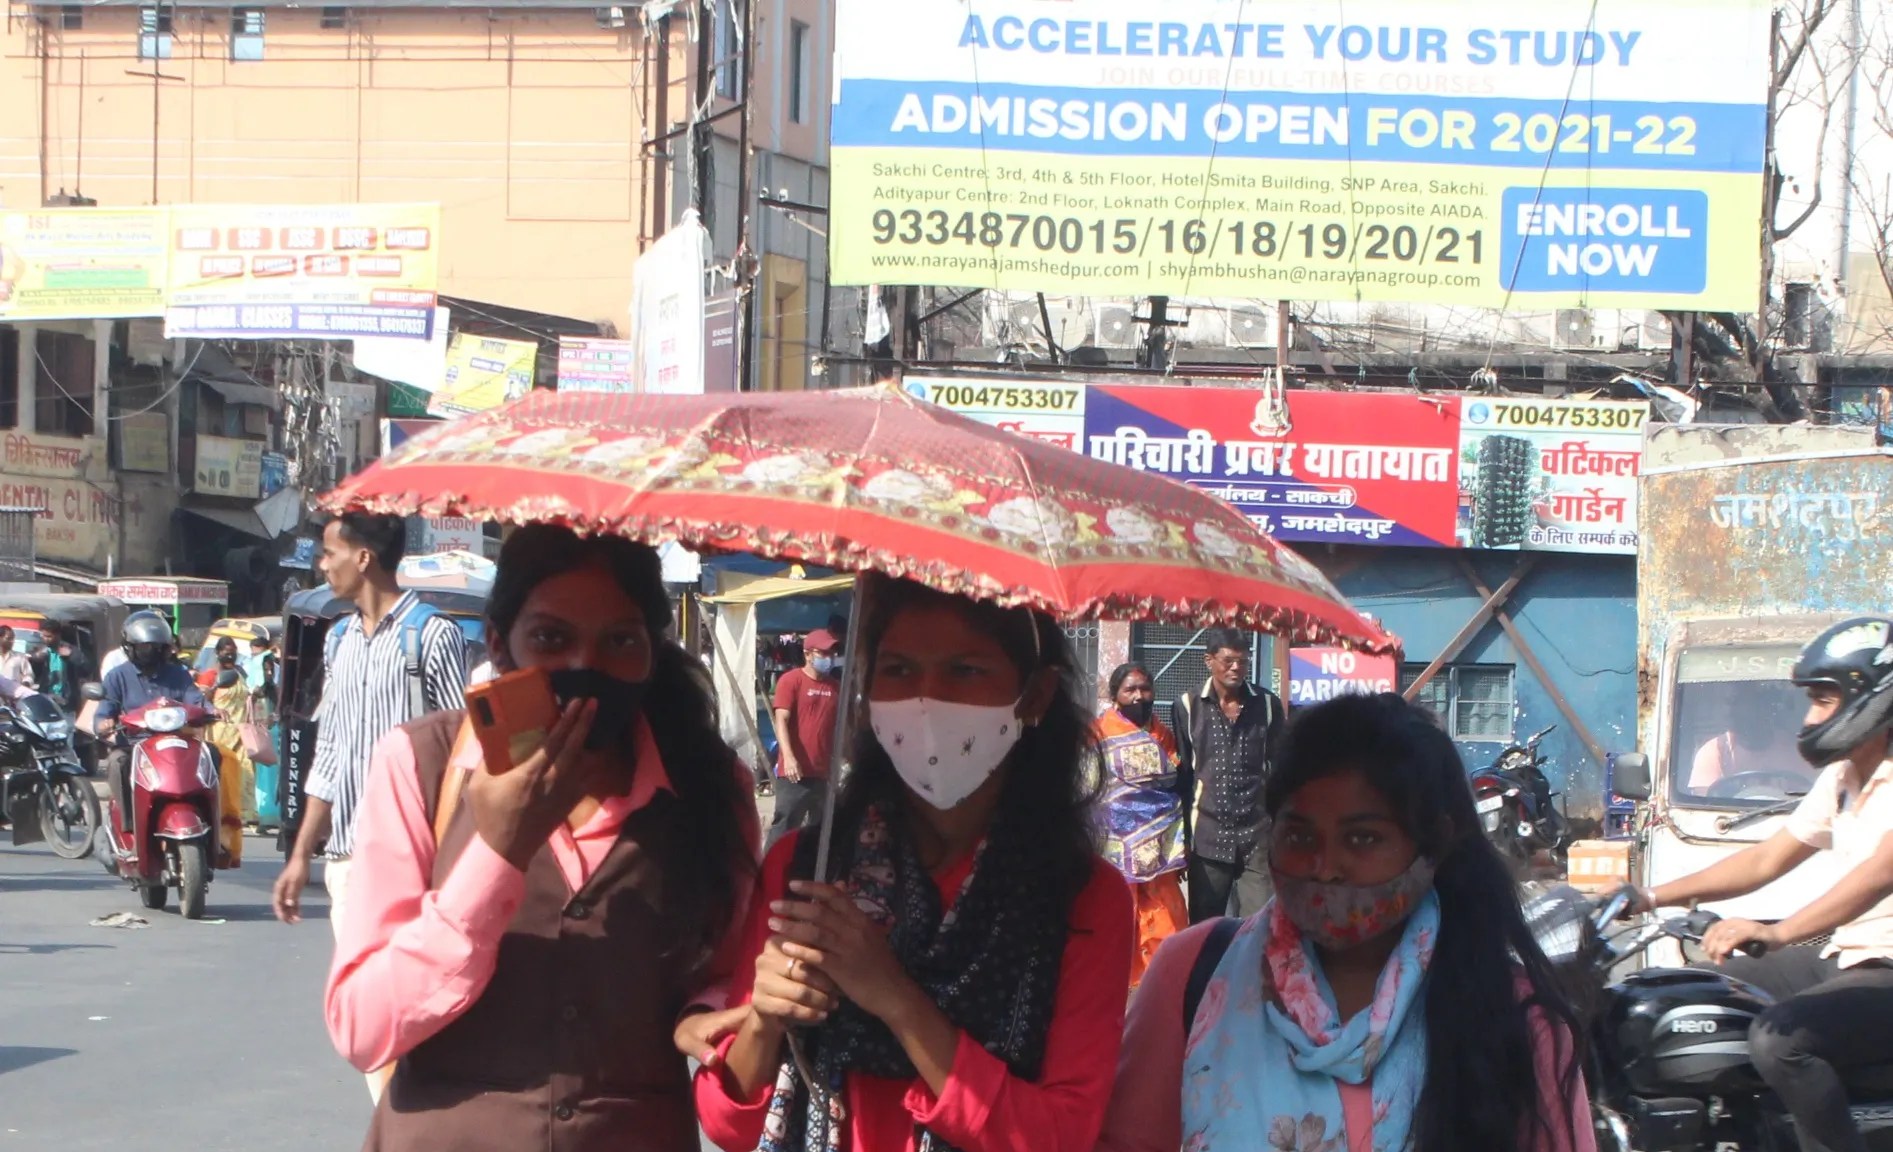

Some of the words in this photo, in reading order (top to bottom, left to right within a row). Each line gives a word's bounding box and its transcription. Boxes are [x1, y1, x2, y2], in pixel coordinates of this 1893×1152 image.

[958, 14, 1285, 58] ACCELERATE
[1303, 24, 1448, 65] YOUR
[1467, 29, 1642, 67] STUDY
[1096, 67, 1155, 86] JOIN
[1168, 68, 1221, 88] OUR
[1233, 69, 1365, 91] FULL-TIME
[1378, 71, 1495, 94] COURSES
[890, 93, 1189, 142] ADMISSION
[1203, 101, 1349, 147] OPEN
[1366, 107, 1475, 149] FOR
[1490, 113, 1697, 156] 2021-22
[872, 163, 927, 178] Sakchi
[932, 164, 990, 180] Centre:
[996, 167, 1026, 183] 3rd,
[1032, 168, 1057, 183] 4th
[1063, 170, 1074, 184] &
[1080, 170, 1104, 186] 5th
[1110, 173, 1156, 188] Floor,
[1162, 173, 1204, 187] Hotel
[1209, 173, 1256, 189] Smita
[1262, 175, 1334, 194] Building,
[1341, 177, 1376, 191] SNP
[1380, 179, 1422, 195] Area,
[1429, 180, 1488, 196] Sakchi.
[873, 186, 951, 203] Adityapur
[956, 187, 1013, 204] Centre:
[1019, 191, 1048, 206] 2nd
[1053, 193, 1097, 211] Floor,
[1104, 195, 1168, 210] Loknath
[1174, 197, 1250, 214] Complex,
[1256, 198, 1294, 213] Main
[1299, 200, 1345, 216] Road,
[1352, 201, 1425, 218] Opposite
[1430, 203, 1488, 220] AIADA.
[872, 208, 1482, 266] 9334870015/16/18/19/20/21
[1517, 203, 1691, 238] ENROLL
[871, 253, 1140, 278] www.narayanajamshedpur.com
[1159, 259, 1481, 288] shyambhushan@narayanagroup.com
[1547, 242, 1659, 277] NOW
[931, 385, 1079, 410] 7004753307
[1495, 404, 1645, 428] 7004753307
[1225, 440, 1297, 478] प्रवर
[1303, 444, 1452, 483] यातायात
[1540, 441, 1642, 477] वर्टिकल
[0, 483, 54, 519] ENTAL
[1285, 488, 1352, 505] साकची
[1552, 488, 1627, 523] गार्डेन
[1281, 513, 1396, 539] जमशेदपुर
[1531, 527, 1543, 543] के
[1547, 528, 1573, 544] लिए
[1578, 529, 1616, 545] सम्पर्क
[1321, 652, 1356, 675] NO
[1290, 678, 1392, 702] PARKING
